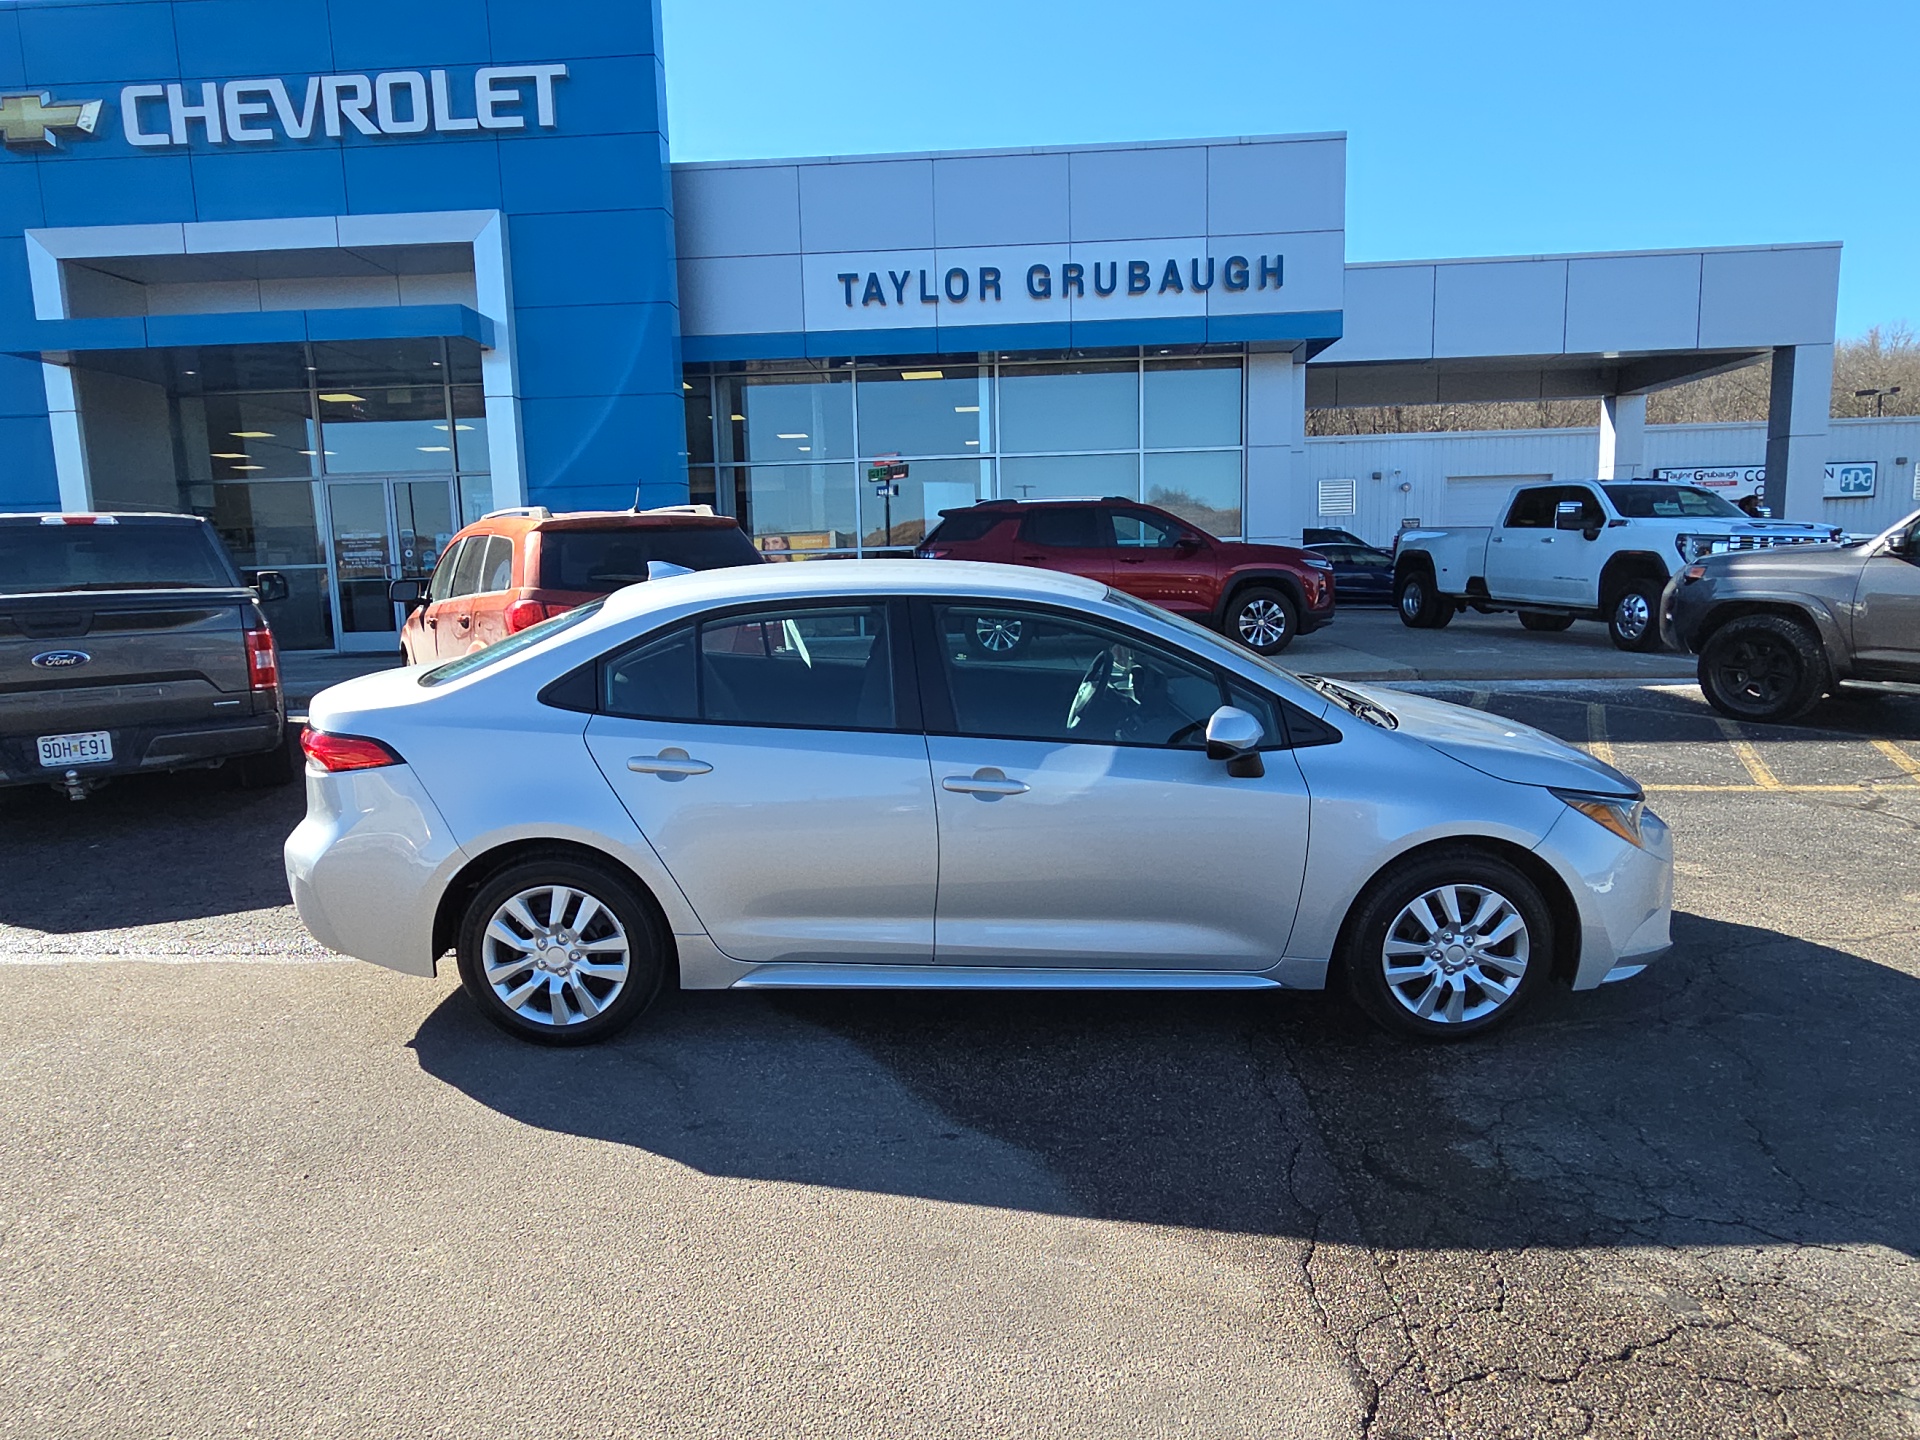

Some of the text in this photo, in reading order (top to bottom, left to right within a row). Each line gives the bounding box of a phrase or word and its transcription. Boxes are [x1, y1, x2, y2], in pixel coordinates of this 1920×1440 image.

[121, 63, 568, 147] CHEVROLET
[838, 254, 1284, 307] TAYLOR GRUBAUGH
[1663, 470, 1738, 480] Taylor Grubaugh
[1841, 469, 1871, 490] PPG
[45, 654, 77, 666] Ford
[42, 739, 107, 759] 9DH E91
